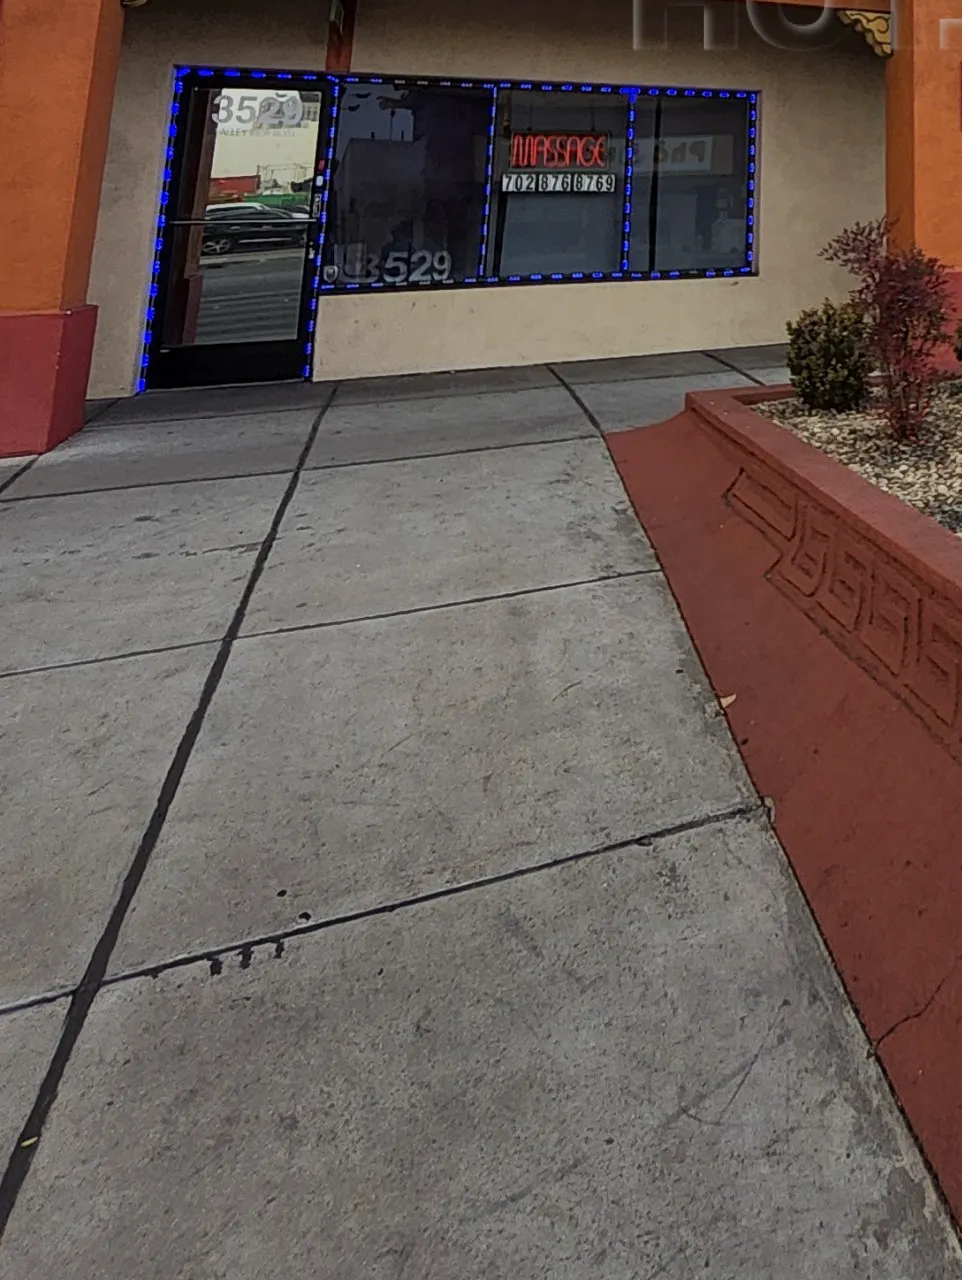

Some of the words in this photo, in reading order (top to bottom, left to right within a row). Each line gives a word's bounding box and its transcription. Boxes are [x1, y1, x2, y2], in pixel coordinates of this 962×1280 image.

[211, 95, 302, 124] 3529
[511, 133, 606, 167] MASSAGE
[504, 174, 535, 191] 702
[540, 175, 571, 191] 876
[575, 175, 614, 192] 8769
